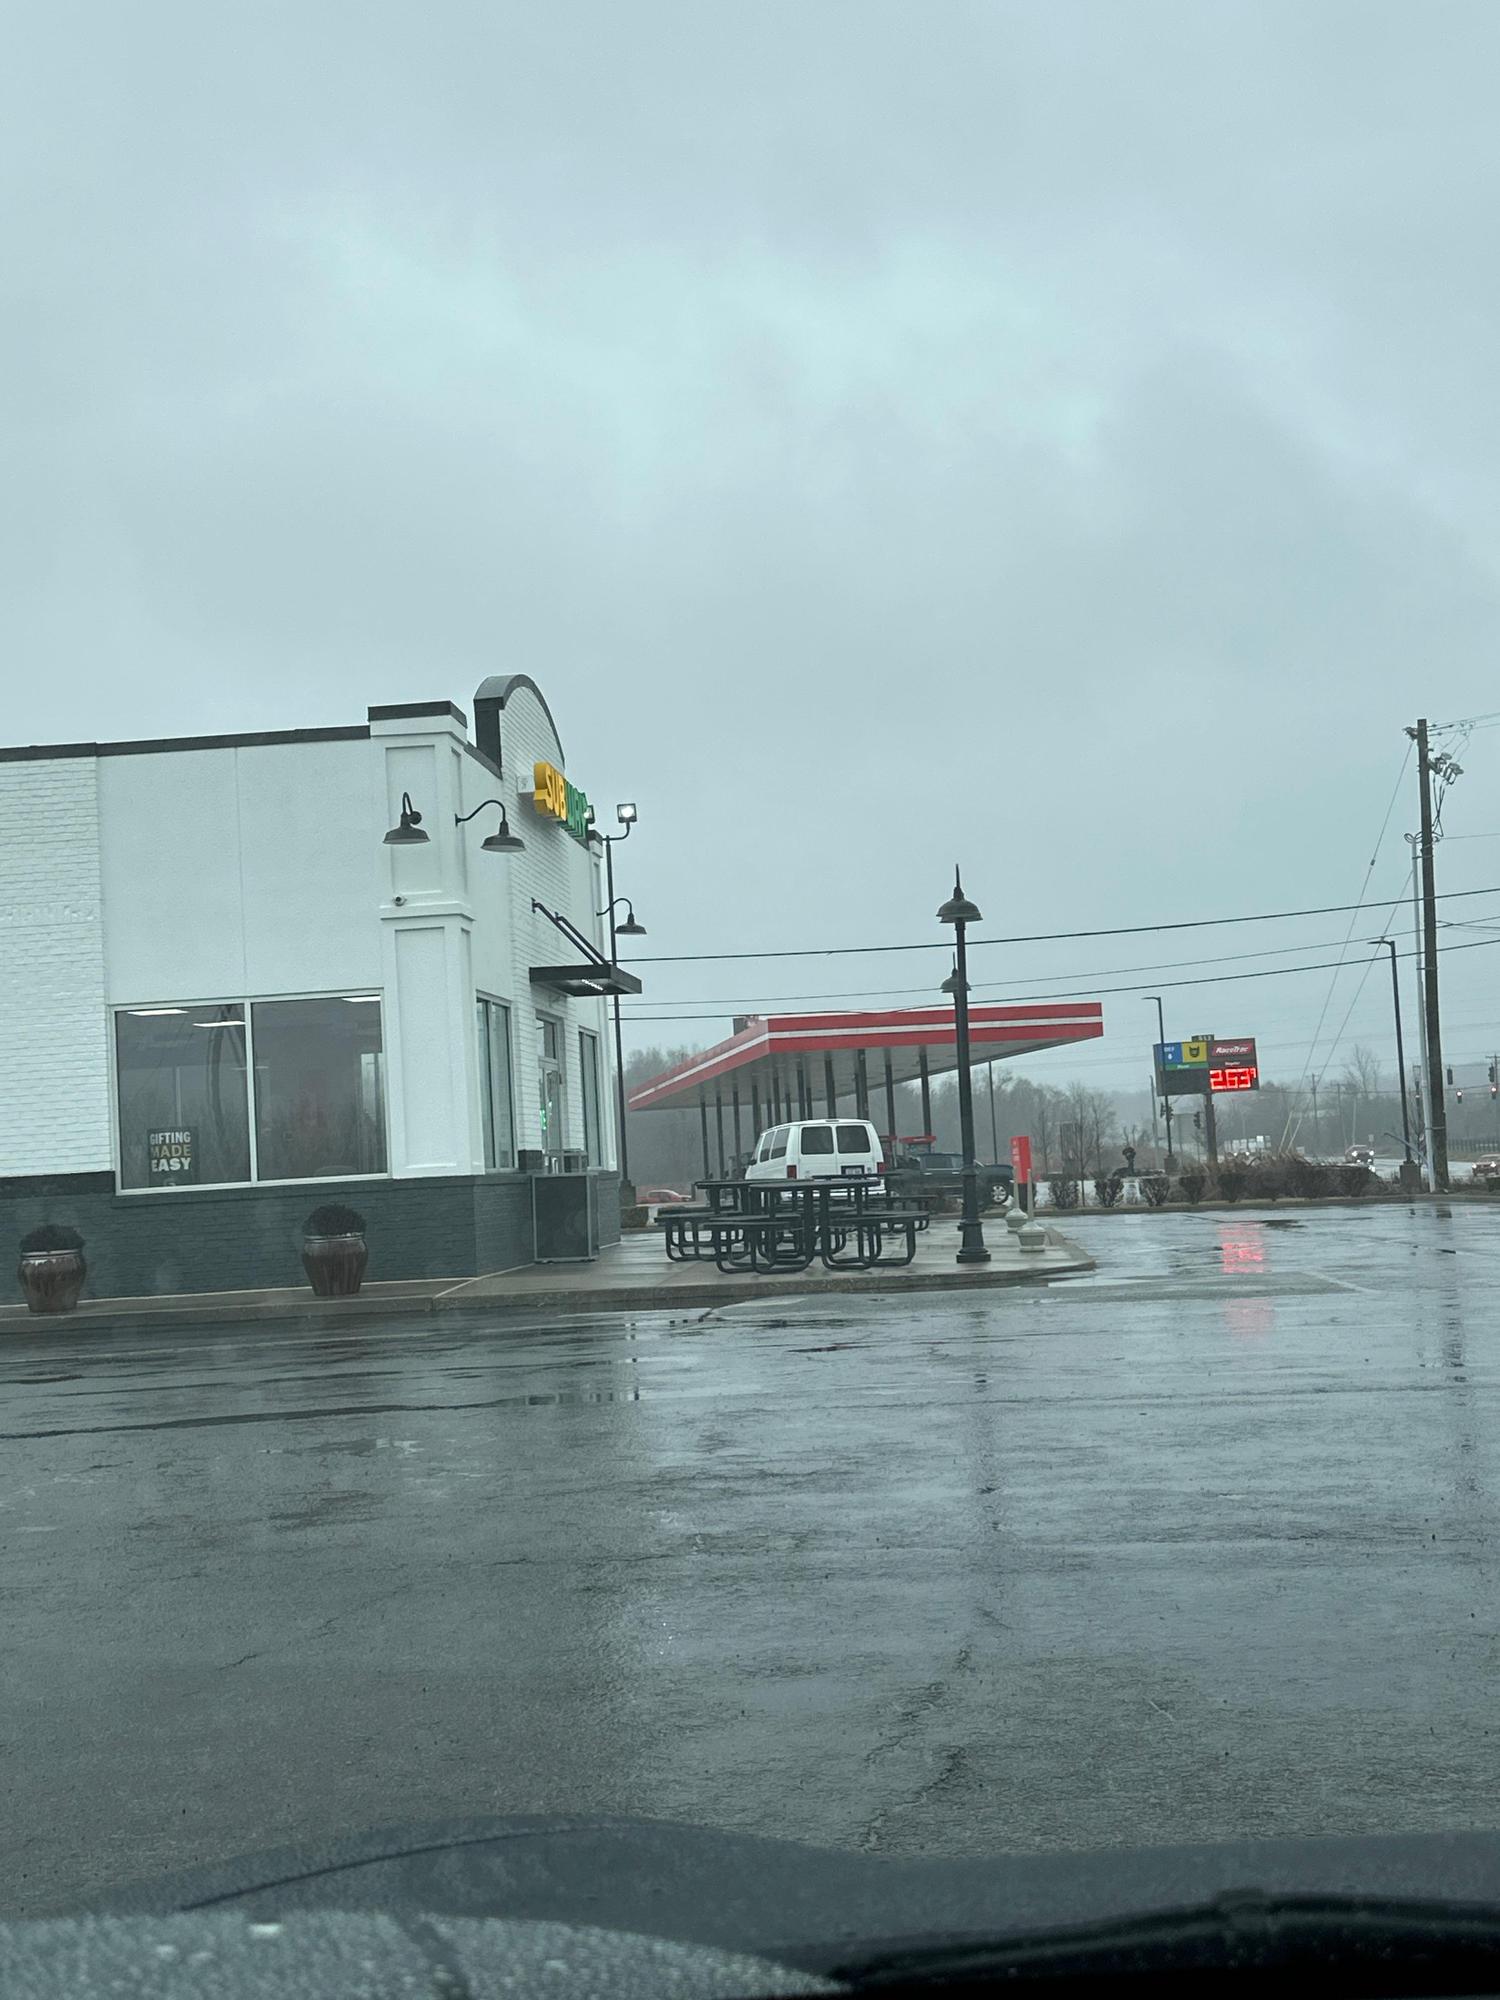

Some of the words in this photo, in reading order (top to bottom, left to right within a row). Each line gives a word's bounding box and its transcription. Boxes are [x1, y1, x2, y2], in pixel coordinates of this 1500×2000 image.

[150, 1131, 191, 1145] GIFTING
[151, 1144, 191, 1158] MADE
[151, 1157, 191, 1172] EASY
